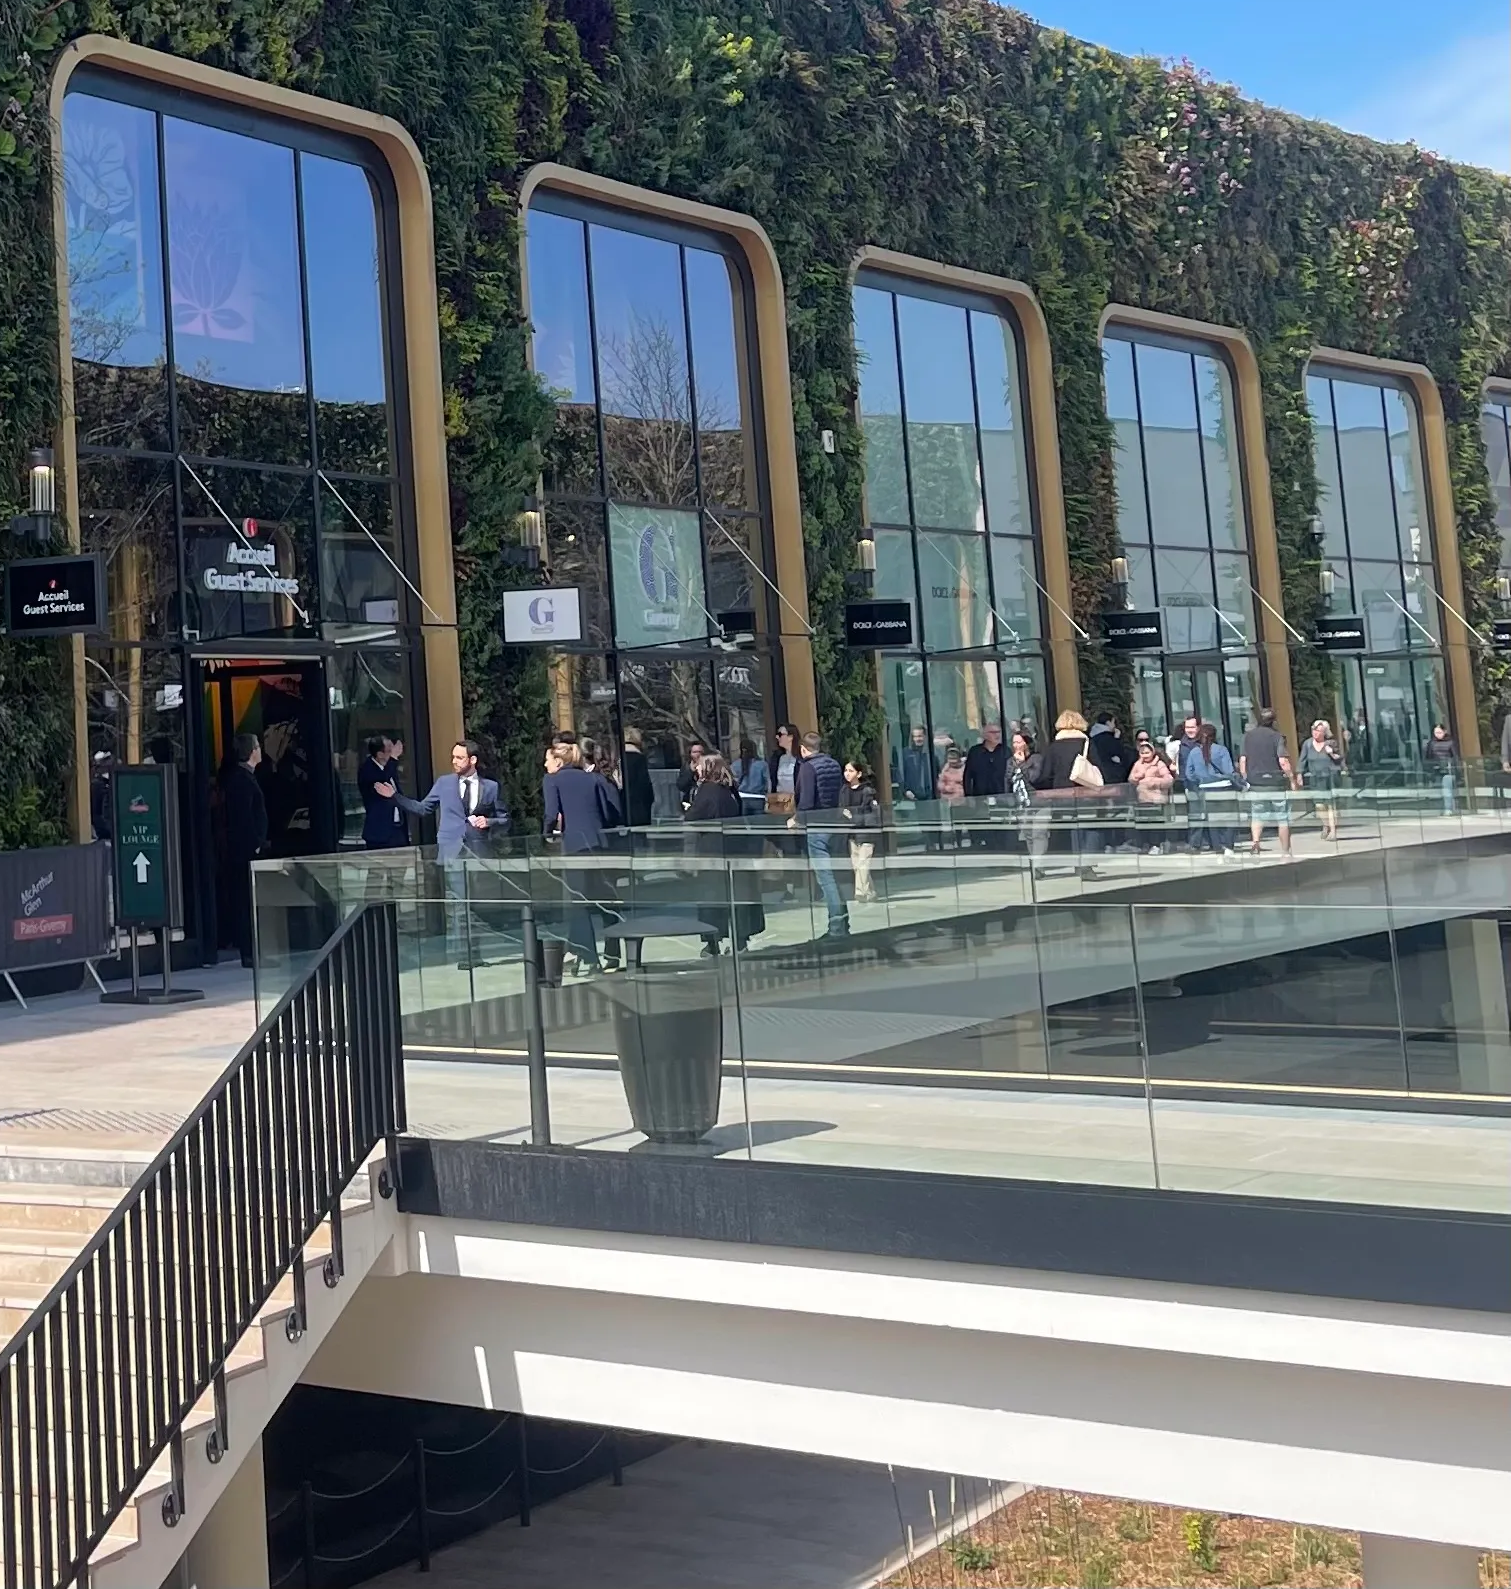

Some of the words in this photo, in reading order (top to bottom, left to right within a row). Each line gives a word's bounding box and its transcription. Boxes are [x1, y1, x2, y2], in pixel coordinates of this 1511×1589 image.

[204, 567, 245, 592] Guest
[245, 570, 300, 595] Services
[37, 589, 69, 602] Accueil
[23, 604, 49, 615] Guest
[49, 600, 85, 613] Services
[528, 596, 555, 625] G
[132, 825, 148, 834] VIP
[122, 834, 160, 844] LOUNGE
[20, 871, 54, 905] McArthur
[24, 897, 42, 917] Glen
